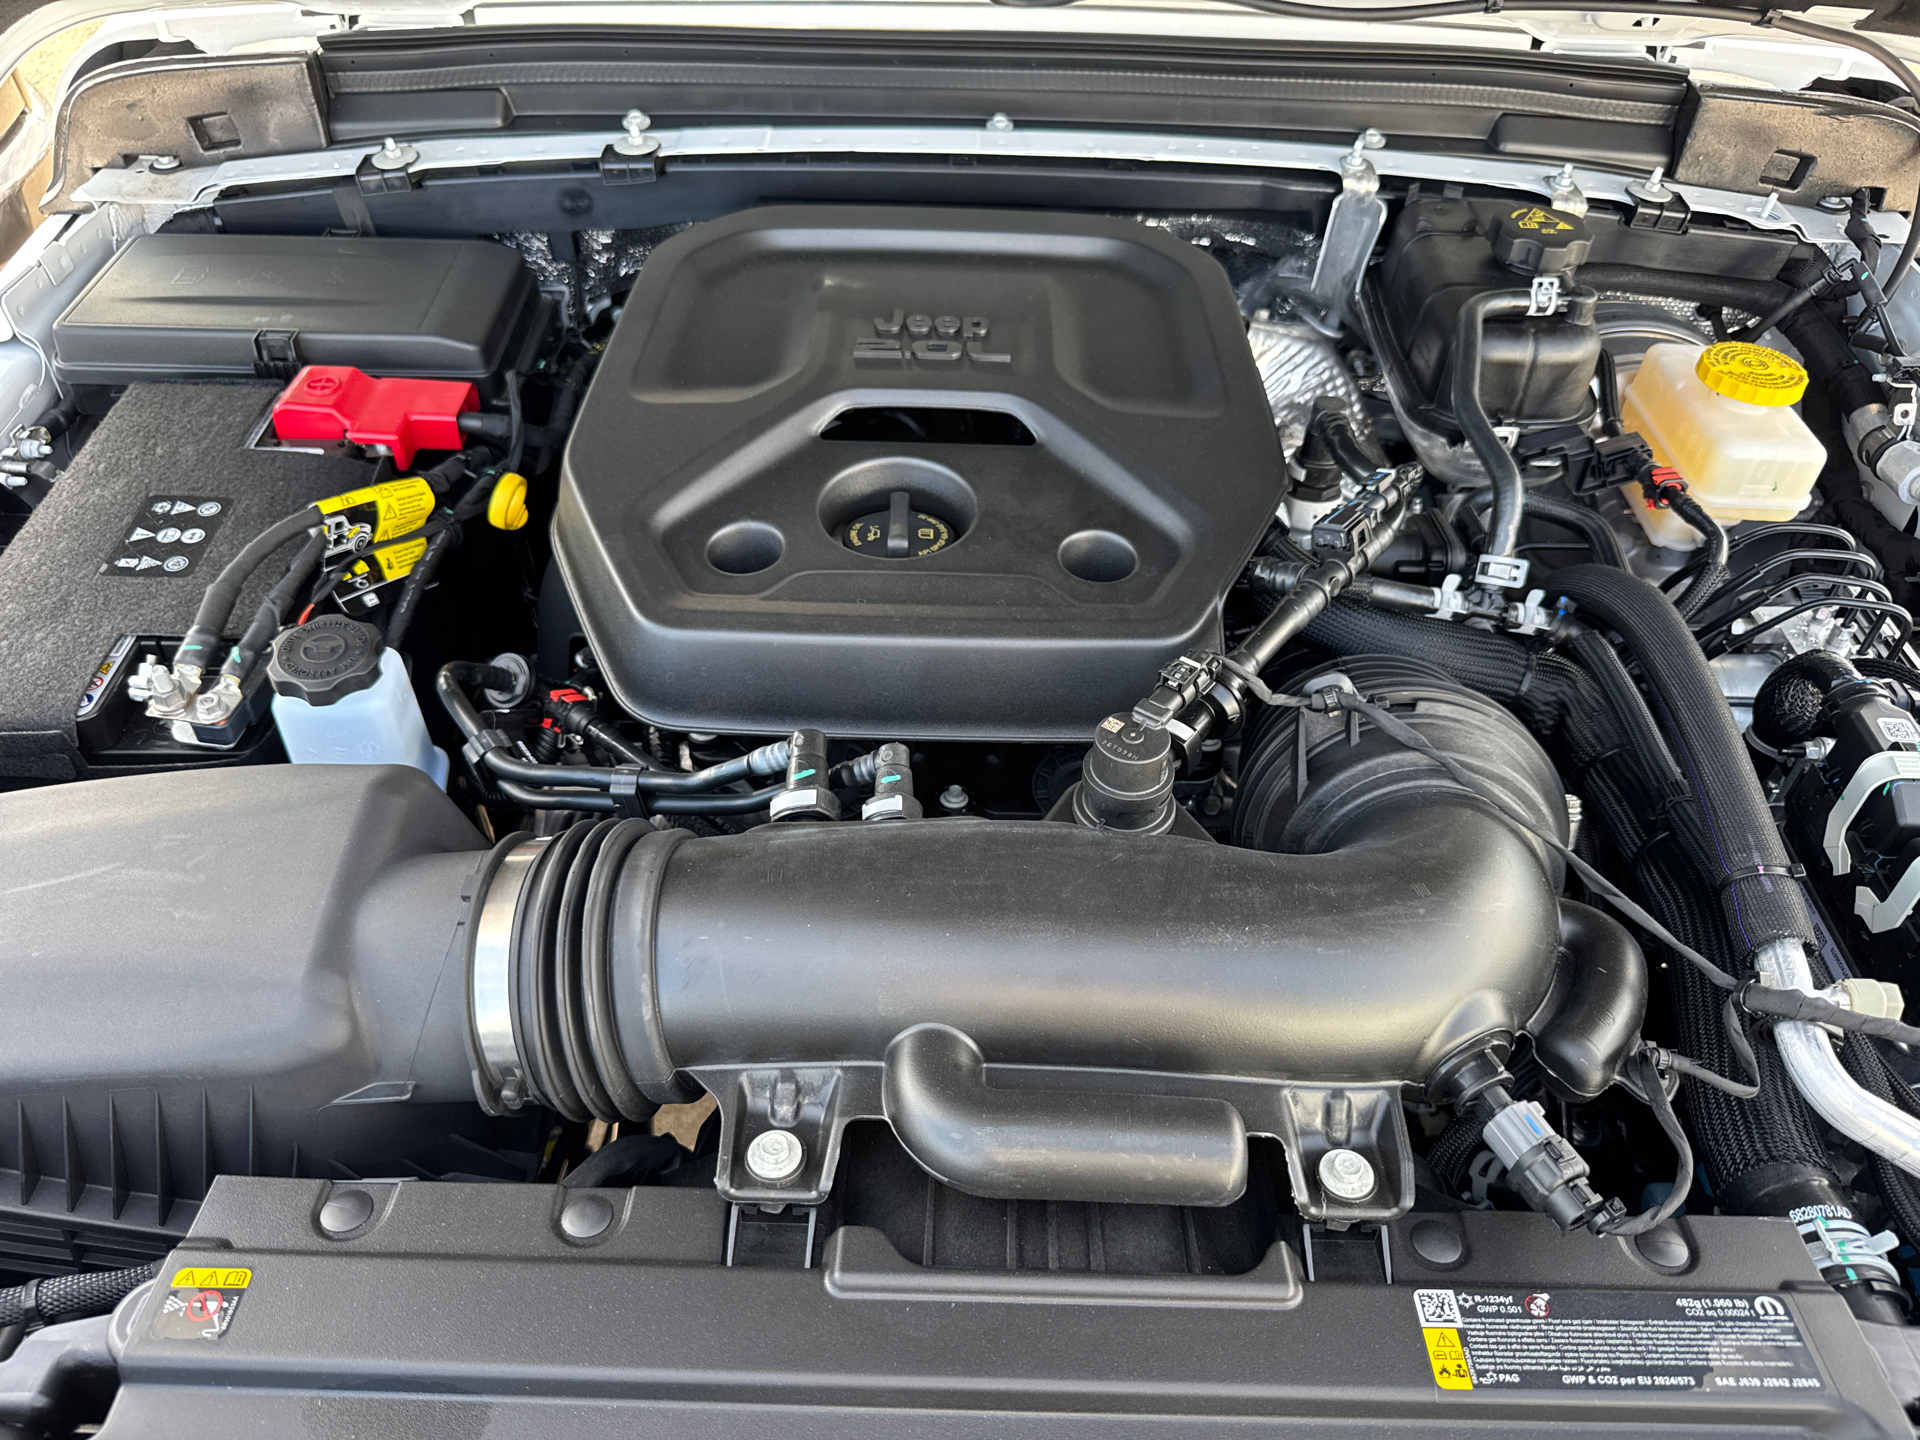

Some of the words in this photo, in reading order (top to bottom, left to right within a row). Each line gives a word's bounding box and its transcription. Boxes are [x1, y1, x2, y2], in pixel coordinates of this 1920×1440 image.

[874, 309, 990, 340] Jeep
[853, 338, 1012, 363] 2.0L
[300, 620, 348, 635] STEERING
[282, 632, 300, 652] FLUID
[285, 661, 338, 677] APPROVED
[1789, 1204, 1853, 1222] 68280781AD
[1474, 1295, 1513, 1304] R-1234yf
[1675, 1298, 1701, 1309] 482g
[1701, 1299, 1733, 1309] (1.060
[1734, 1299, 1750, 1309] lb)
[1477, 1305, 1499, 1313] GWP
[1500, 1306, 1522, 1314] 0.501
[1685, 1308, 1705, 1316] CO2
[1719, 1308, 1750, 1316] 0.00024
[1499, 1373, 1520, 1382] PAG
[1562, 1375, 1587, 1384] GWP
[1588, 1375, 1596, 1384] &
[1597, 1375, 1618, 1385] CO2
[1620, 1377, 1636, 1386] per
[1637, 1376, 1651, 1385] EU
[1653, 1376, 1696, 1386] 2024/573
[1714, 1377, 1737, 1386] SAE
[1738, 1378, 1760, 1387] J639
